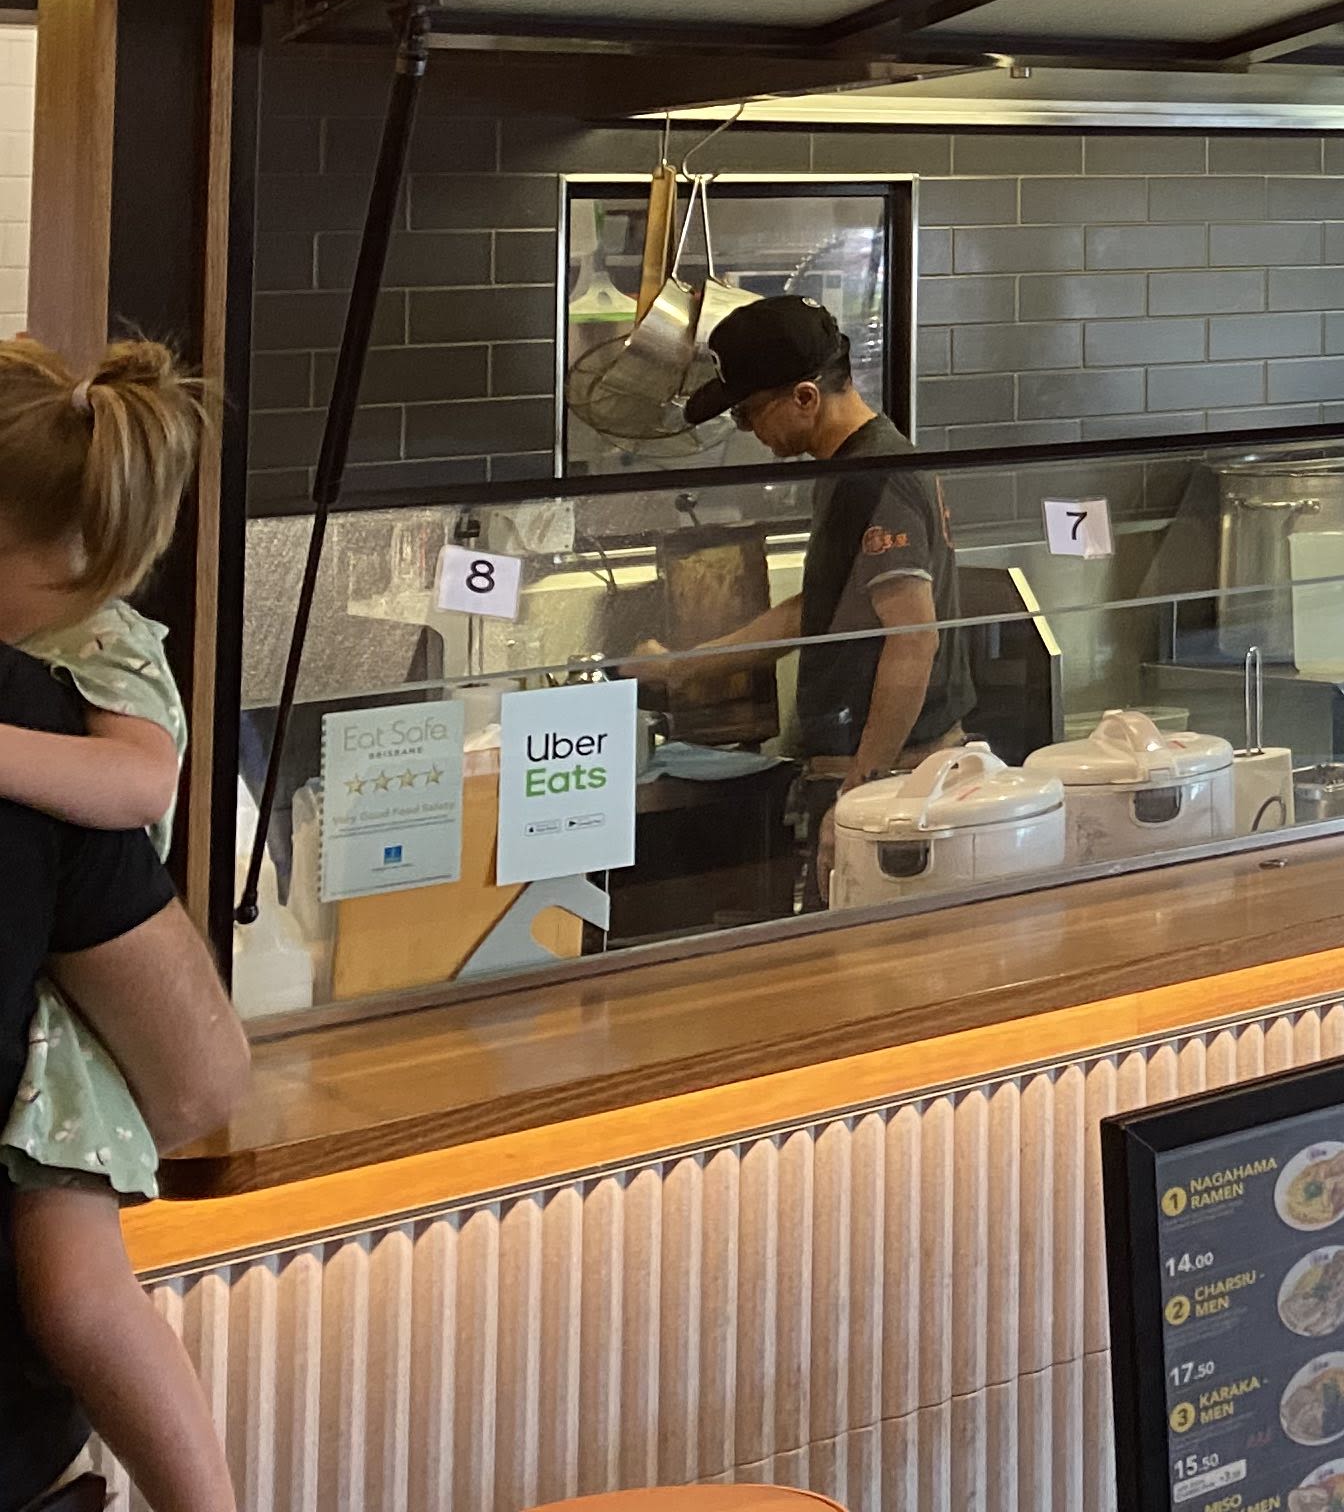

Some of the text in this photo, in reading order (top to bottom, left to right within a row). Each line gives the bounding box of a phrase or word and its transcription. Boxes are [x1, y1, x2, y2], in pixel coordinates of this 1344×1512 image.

[1065, 509, 1089, 541] 7
[465, 559, 495, 595] 8
[343, 716, 448, 752] Eat Safe
[368, 746, 423, 760] BRISBANE
[526, 732, 608, 763] Uber
[525, 764, 607, 798] Eats
[1190, 1158, 1278, 1193] NAGAHAMA
[1169, 1192, 1179, 1211] 1
[1191, 1183, 1244, 1209] RAMEN
[1165, 1251, 1214, 1277] 14.00
[1194, 1270, 1256, 1300] CHARSIU
[1172, 1301, 1183, 1320] 2
[1194, 1295, 1230, 1317] MEN
[1169, 1361, 1216, 1387] 17.50
[1199, 1376, 1261, 1408] KARAKA
[1177, 1407, 1188, 1427] 3
[1200, 1402, 1234, 1424] MEN
[1174, 1453, 1219, 1479] 15.50
